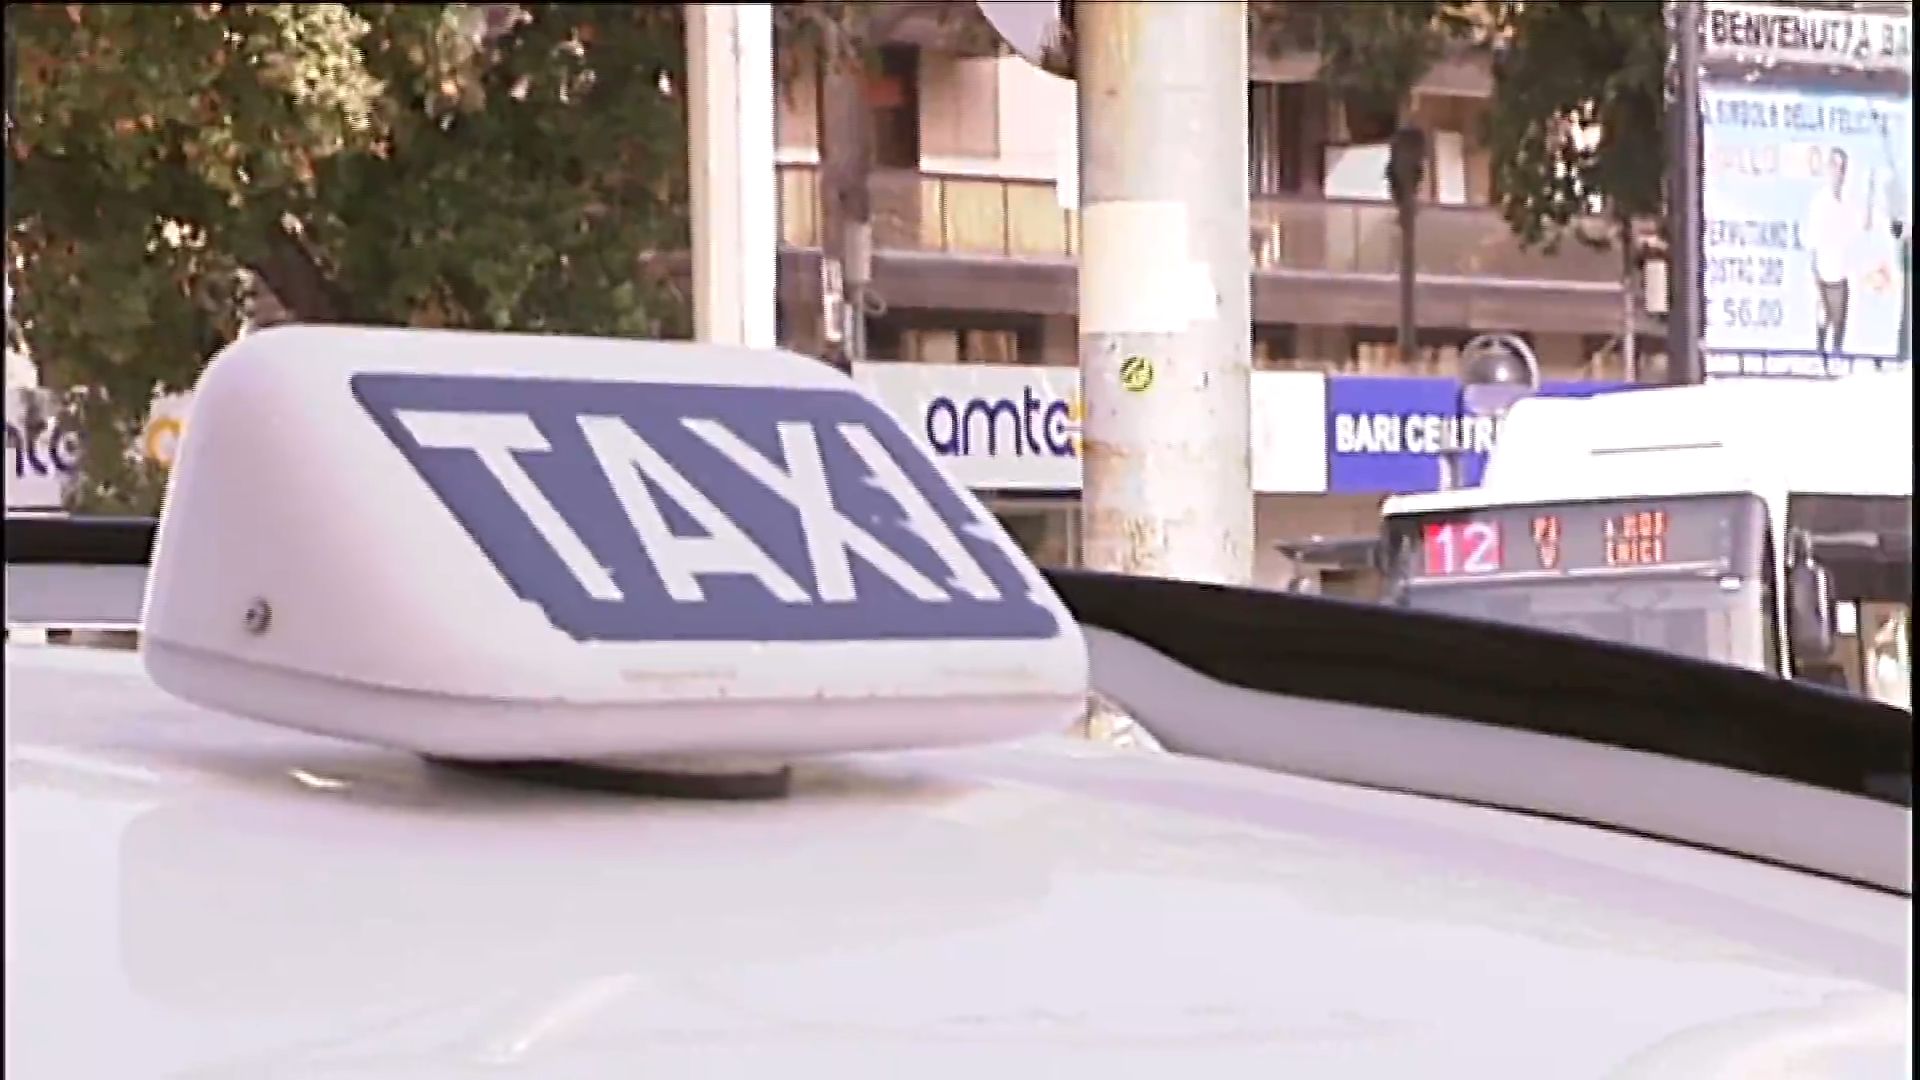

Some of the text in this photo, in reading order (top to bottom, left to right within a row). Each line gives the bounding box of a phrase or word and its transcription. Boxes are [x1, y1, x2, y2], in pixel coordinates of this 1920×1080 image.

[1335, 412, 1496, 453] BARI CETR
[397, 409, 1002, 603] TAXI
[1434, 520, 1498, 575] 12
